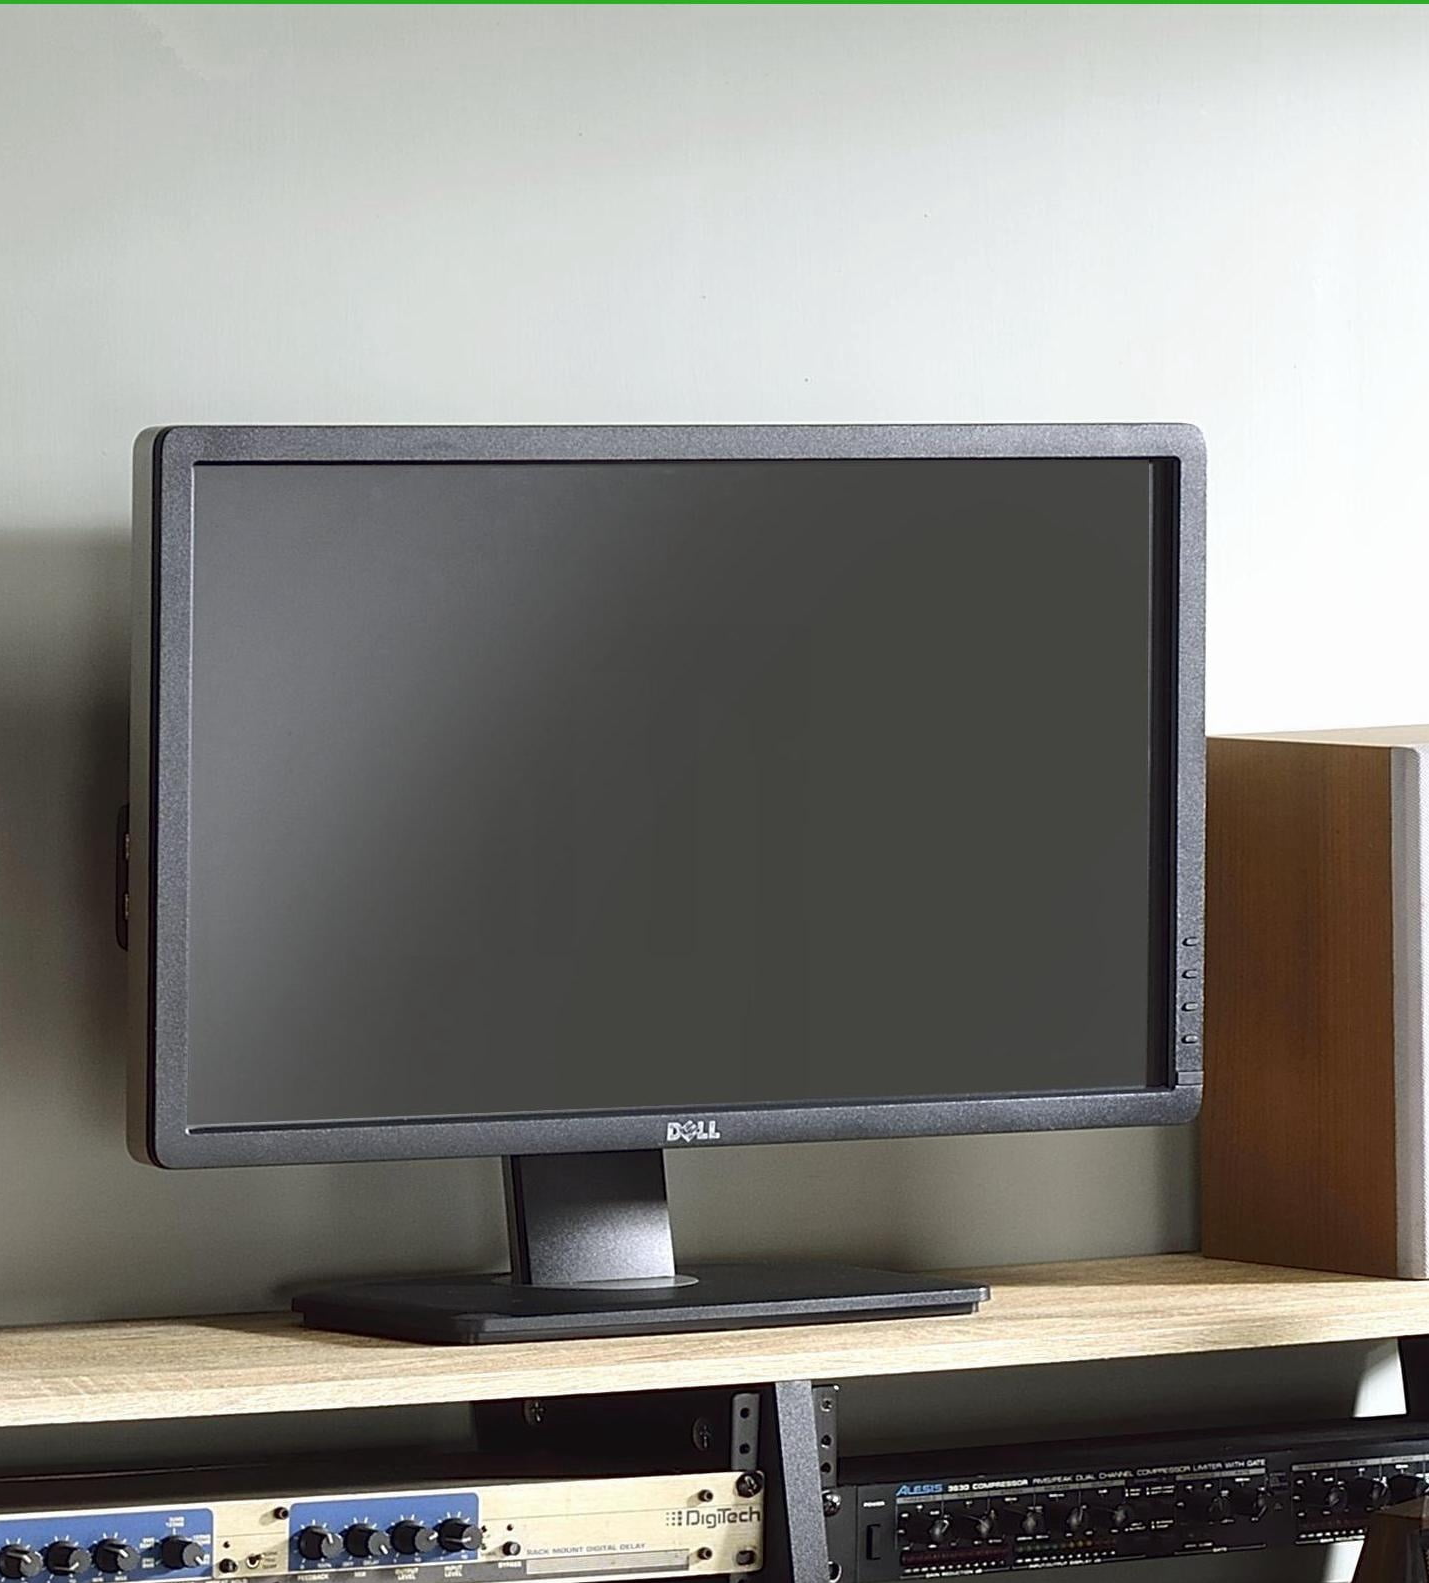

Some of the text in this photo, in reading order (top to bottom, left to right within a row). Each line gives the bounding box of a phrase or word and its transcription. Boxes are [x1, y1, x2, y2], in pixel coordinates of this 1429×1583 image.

[667, 1120, 720, 1142] DELL
[896, 1483, 943, 1496] ALESIS
[972, 1479, 1028, 1490] COMPRESSOR
[1075, 1473, 1097, 1482] DUAL
[1098, 1470, 1134, 1480] CHANNEL
[1136, 1465, 1191, 1477] COMPRESSOR
[1193, 1462, 1222, 1472] LIMITER
[1224, 1460, 1245, 1469] WITH
[1246, 1458, 1266, 1467] GATE
[685, 1506, 761, 1529] DigiTech
[526, 1543, 646, 1556] RACK MOUNT DIGITAL DELAY
